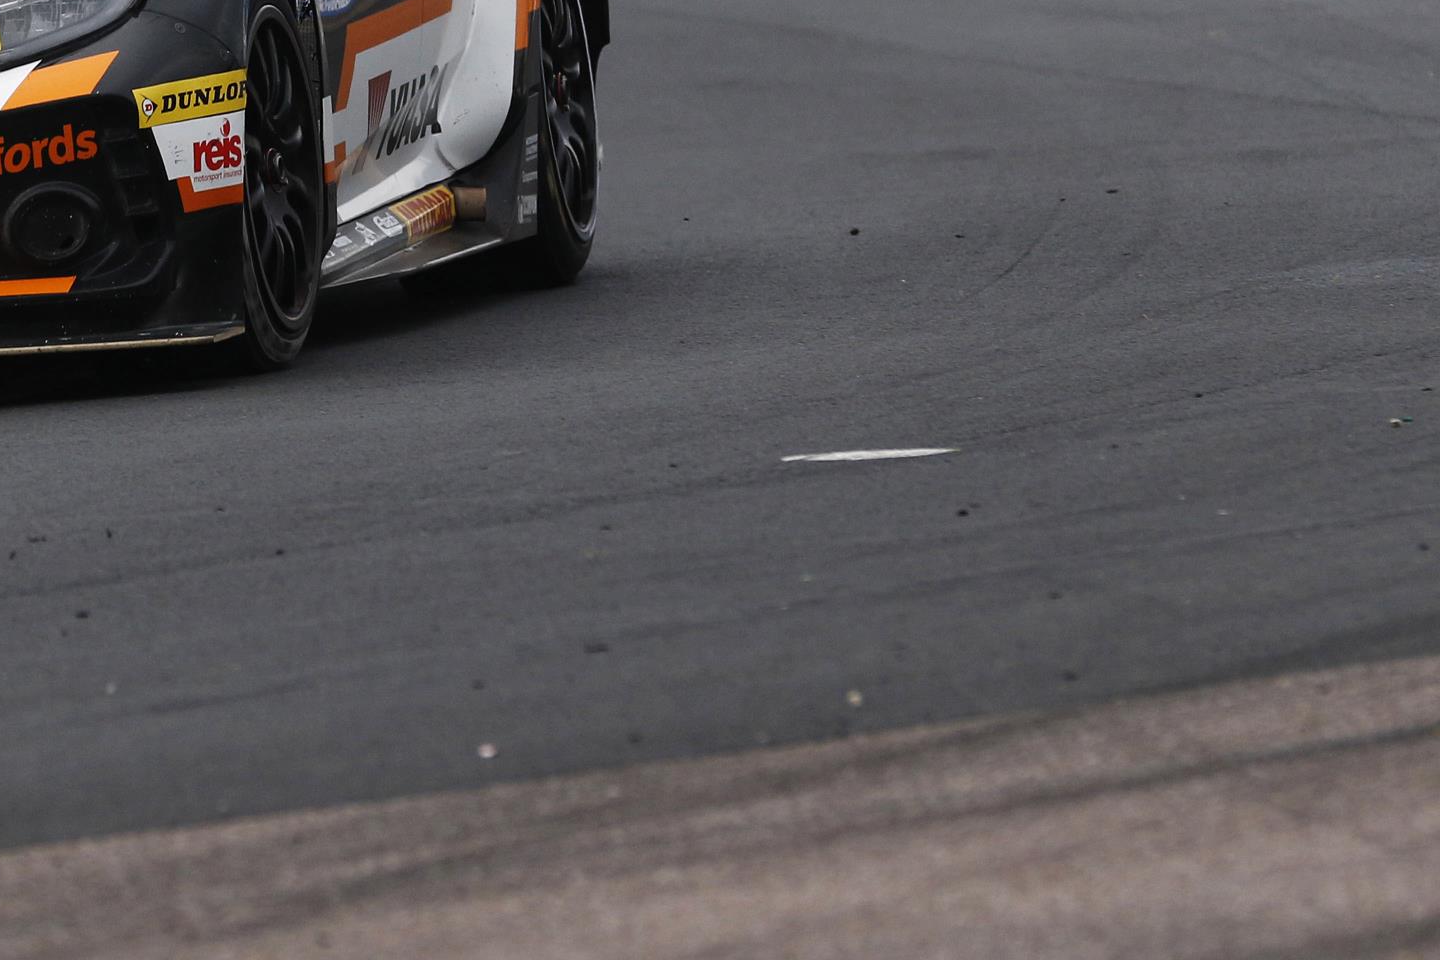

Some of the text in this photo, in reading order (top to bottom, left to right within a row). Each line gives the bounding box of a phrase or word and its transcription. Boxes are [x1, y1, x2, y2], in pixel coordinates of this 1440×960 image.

[161, 81, 247, 113] DUNLOP
[376, 63, 447, 159] YUASA
[192, 125, 243, 173] reis
